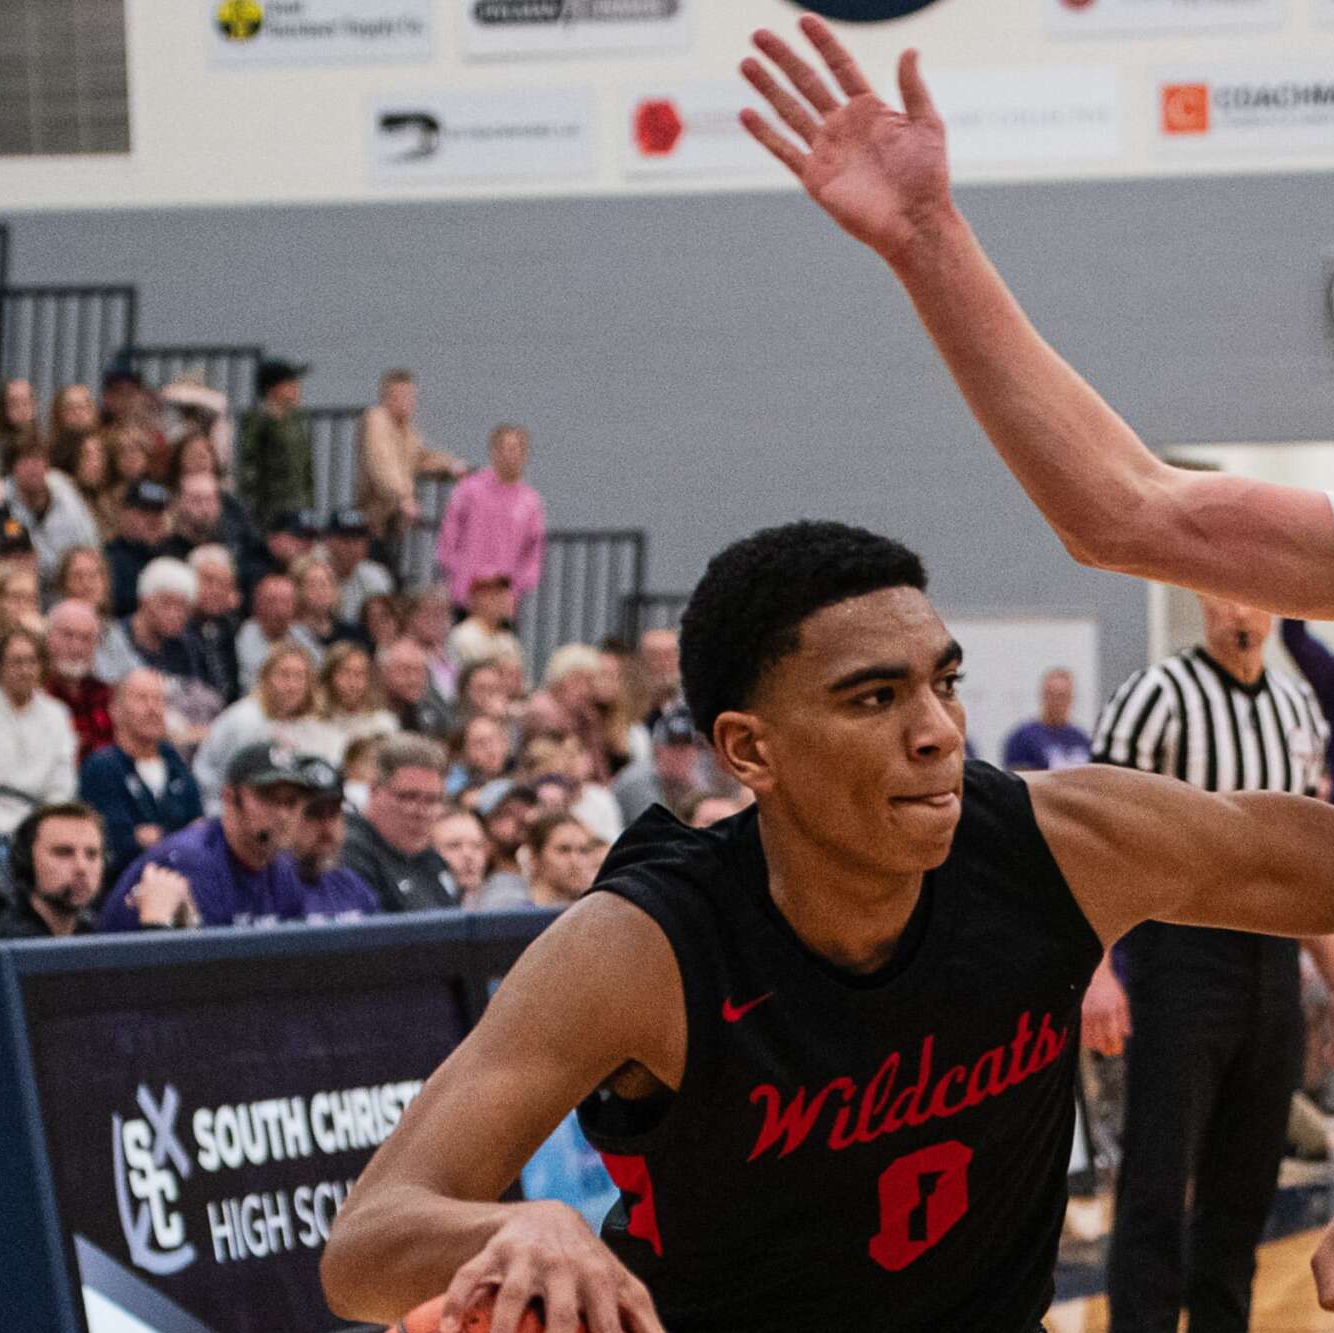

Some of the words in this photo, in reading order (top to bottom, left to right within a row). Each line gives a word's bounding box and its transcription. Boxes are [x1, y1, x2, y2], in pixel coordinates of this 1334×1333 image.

[193, 1097, 310, 1172] SOUTH
[310, 1080, 425, 1154] CHRIST
[747, 1011, 1067, 1162] Wildcats
[207, 1190, 294, 1264] HIGH
[868, 1140, 973, 1273] 0
